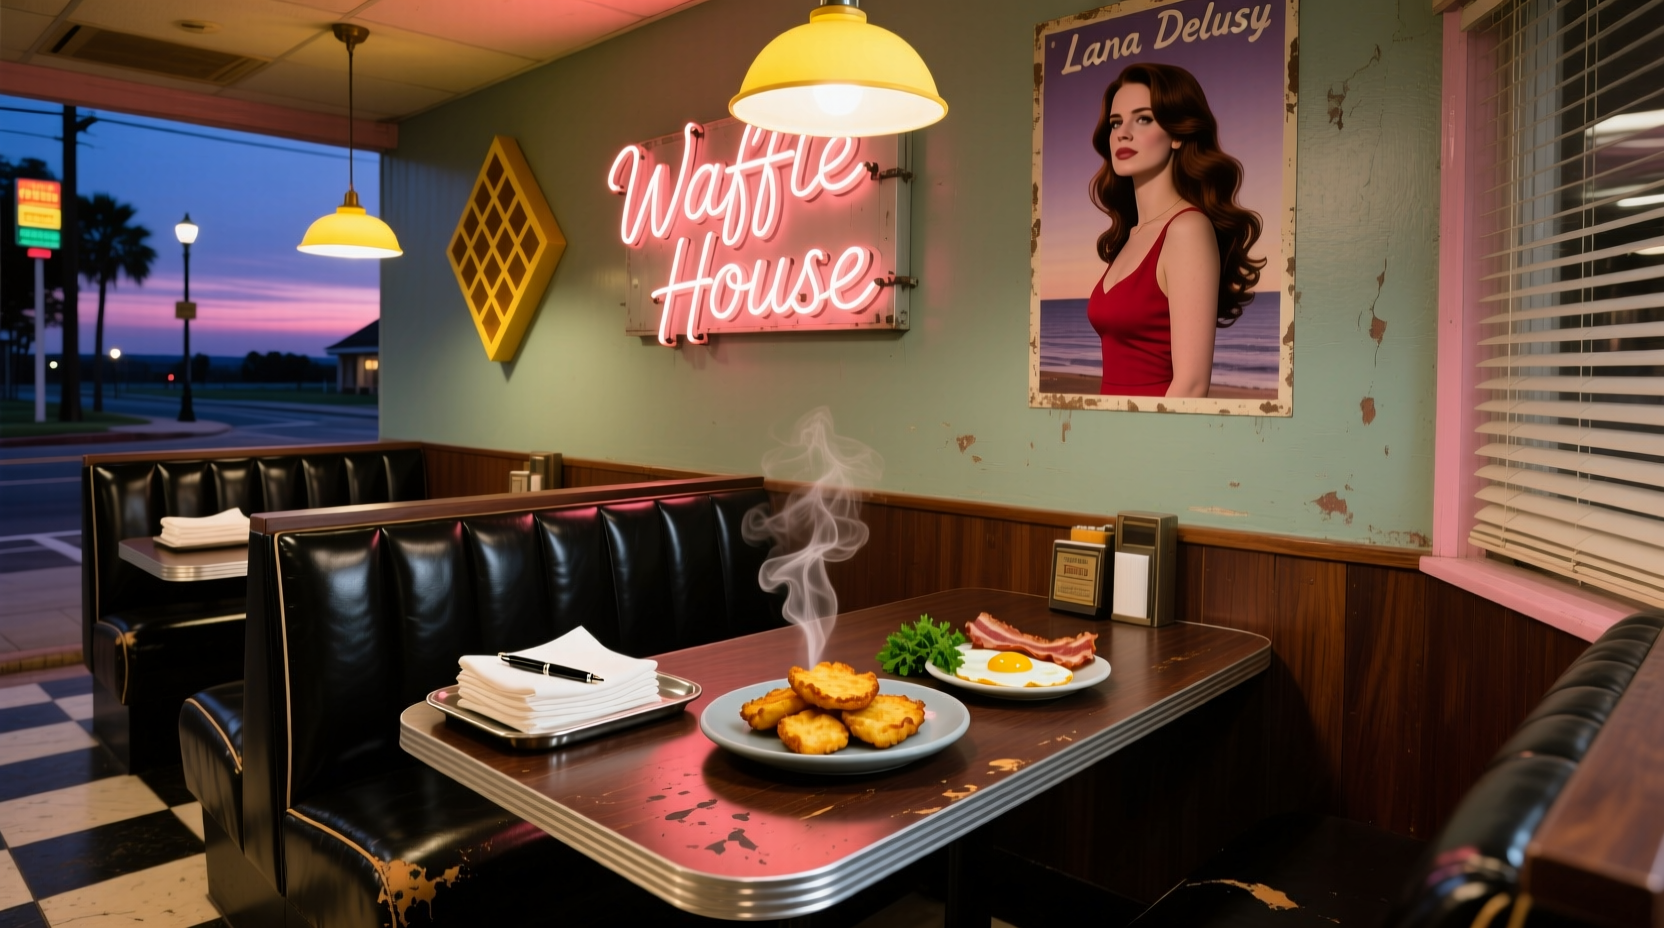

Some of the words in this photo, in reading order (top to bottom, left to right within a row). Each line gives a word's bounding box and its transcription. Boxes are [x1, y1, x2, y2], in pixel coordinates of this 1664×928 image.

[1061, 32, 1142, 75] Lana
[1153, 1, 1272, 50] Delusy
[607, 121, 868, 247] Waffle
[650, 230, 880, 346] House
